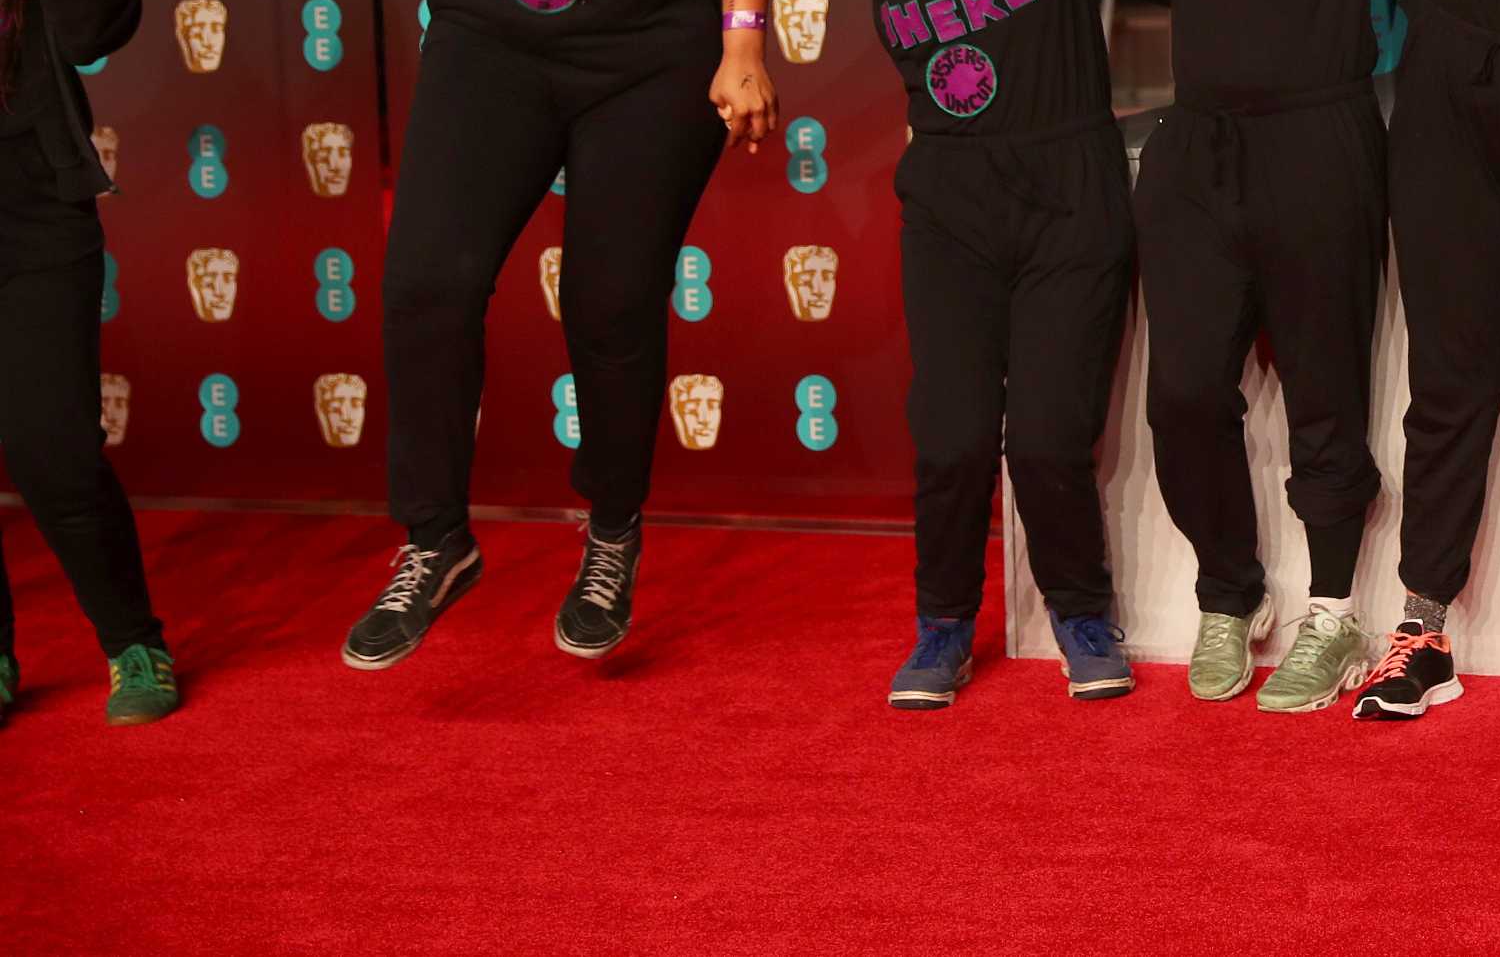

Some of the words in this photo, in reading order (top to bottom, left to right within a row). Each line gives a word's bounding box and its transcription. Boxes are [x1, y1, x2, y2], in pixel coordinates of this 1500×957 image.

[314, 6, 328, 61] EE
[931, 47, 987, 90] SISTERS
[943, 77, 994, 114] UNCUT
[199, 133, 215, 189] EE
[798, 127, 814, 183] EE
[326, 257, 342, 312] EE
[683, 256, 699, 312] EE
[212, 383, 226, 437] EE
[809, 385, 823, 441] EE
